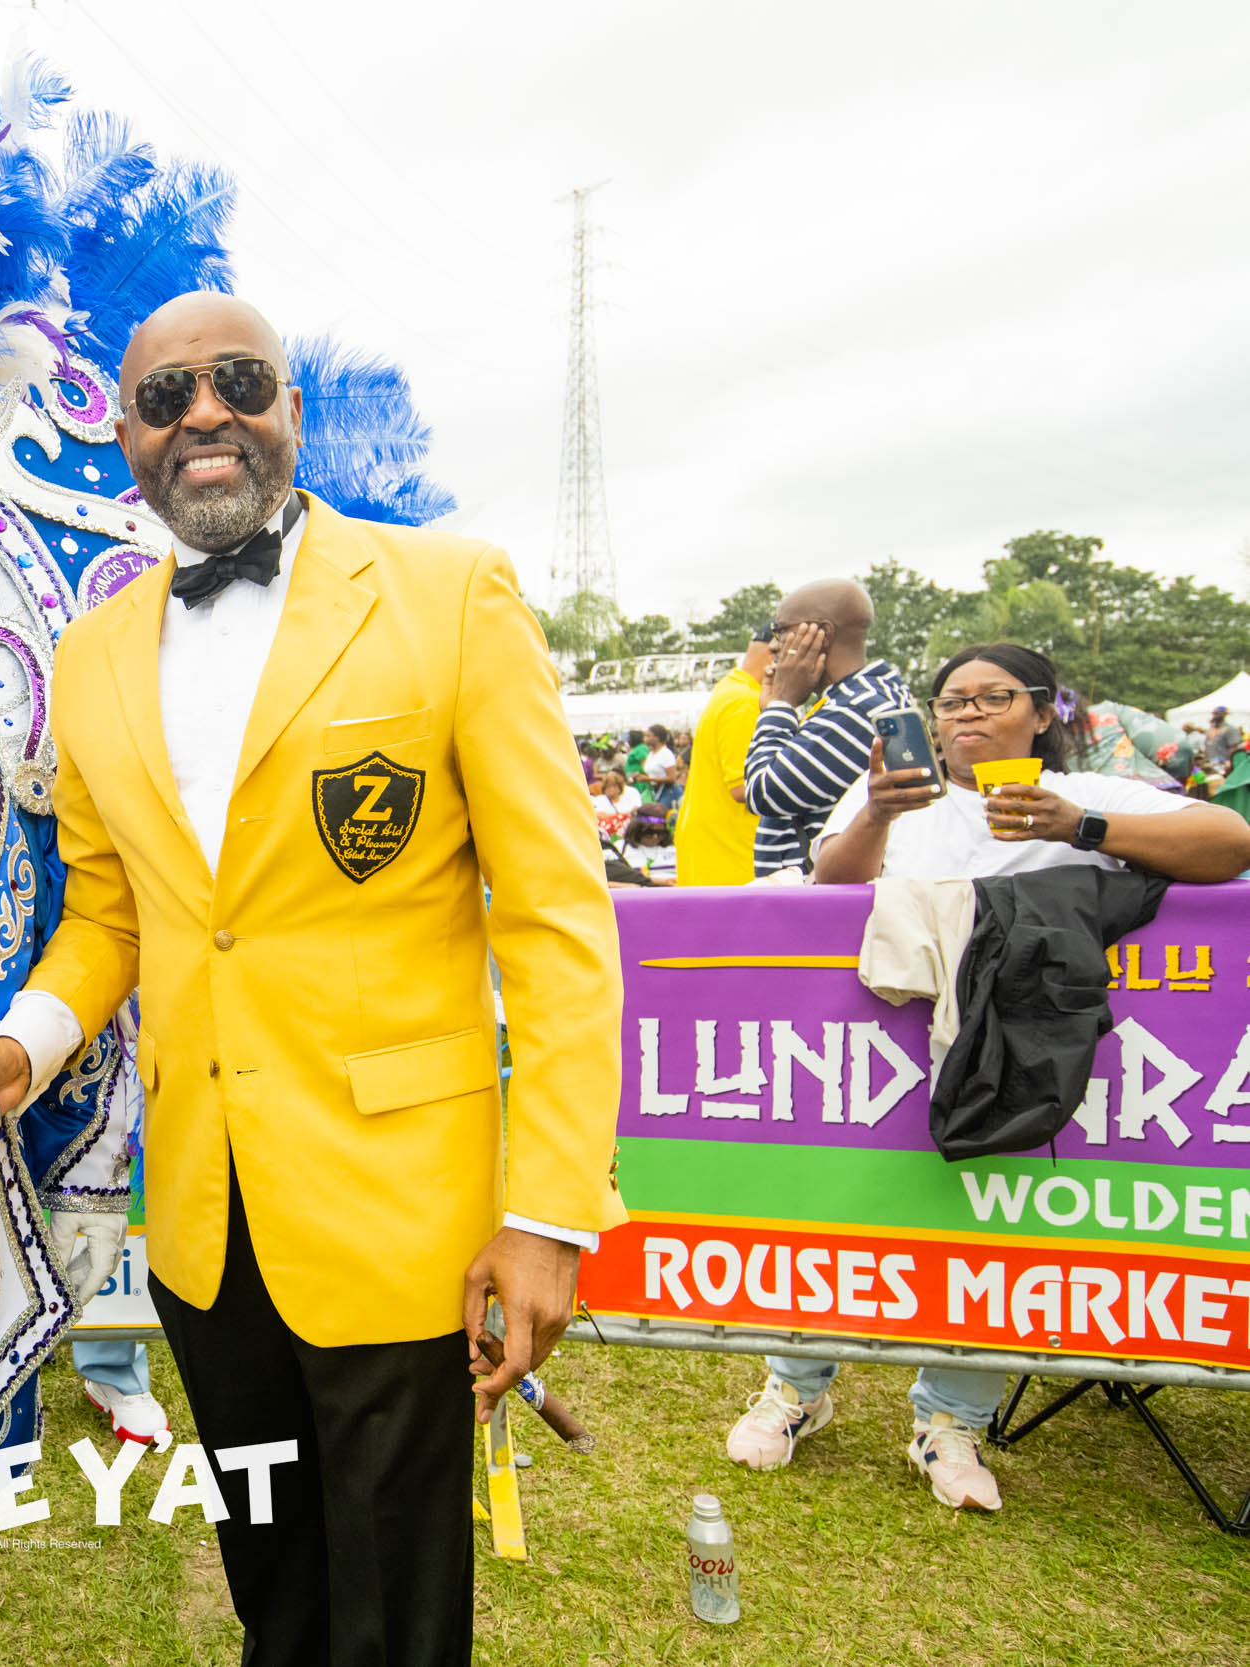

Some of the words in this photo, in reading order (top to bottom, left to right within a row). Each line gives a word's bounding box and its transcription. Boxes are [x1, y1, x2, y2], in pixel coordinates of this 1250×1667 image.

[89, 560, 127, 607] RANCIS
[352, 775, 393, 821] Z
[339, 819, 378, 836] Social
[380, 823, 404, 836] Aid
[340, 833, 352, 847] &
[643, 1237, 919, 1320] ROUSES
[688, 1544, 735, 1576] oors
